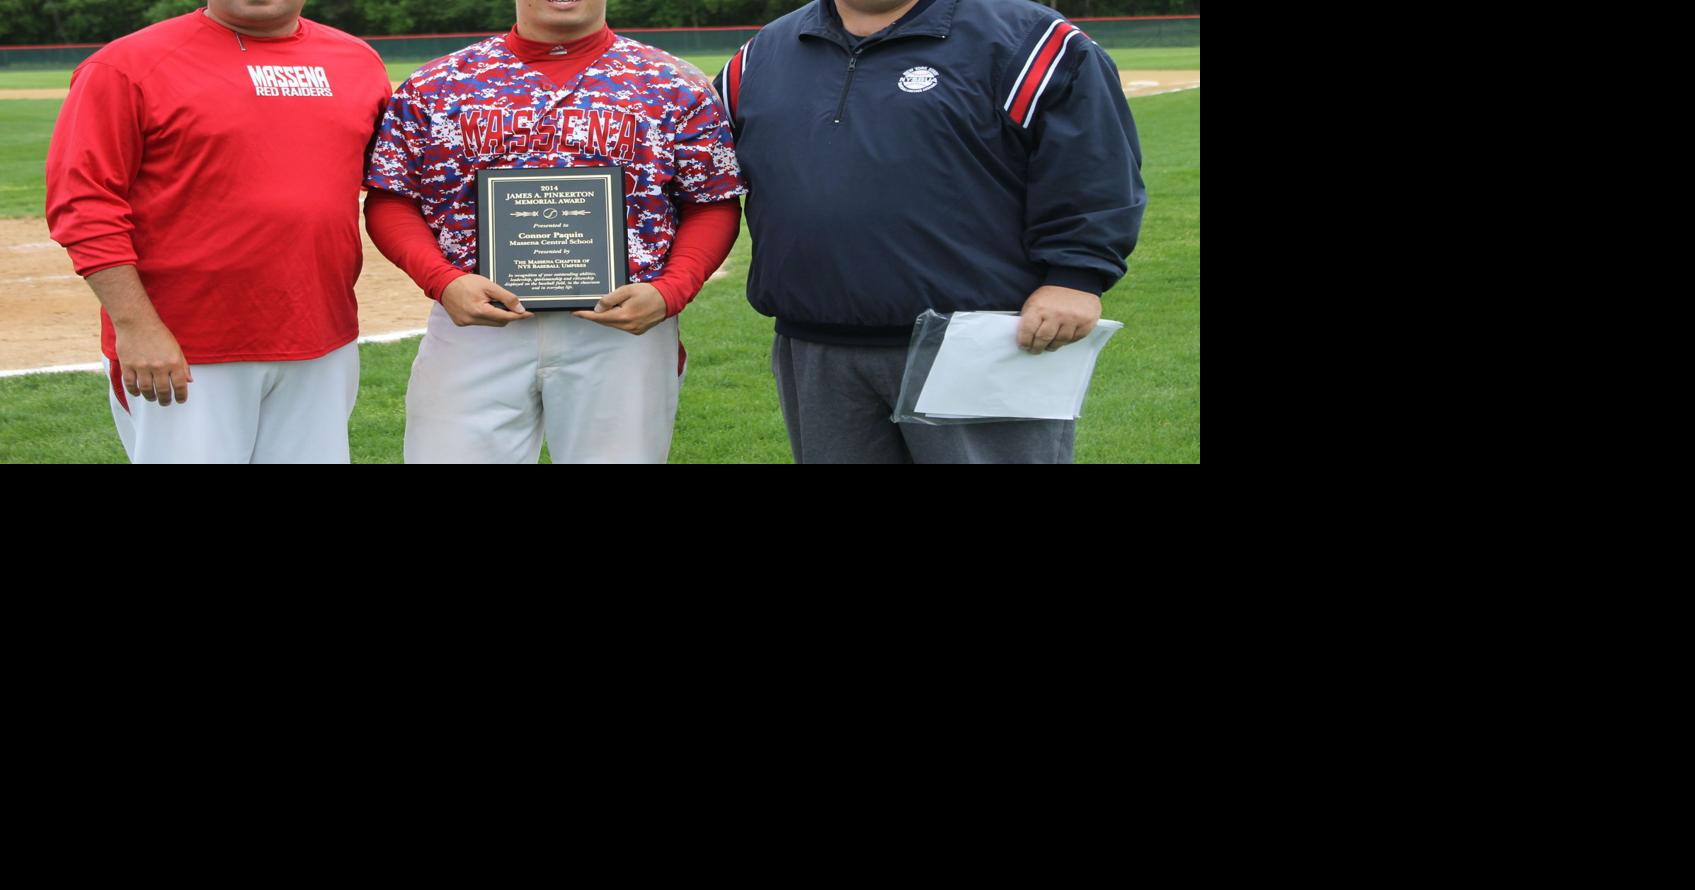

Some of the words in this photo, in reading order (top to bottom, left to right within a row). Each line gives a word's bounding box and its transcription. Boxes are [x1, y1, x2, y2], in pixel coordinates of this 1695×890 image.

[246, 65, 331, 88] MASSENA
[255, 86, 280, 96] RED
[281, 87, 333, 97] RAIDERS
[459, 107, 637, 161] MASSENA
[505, 192, 533, 200] JAMES
[553, 231, 584, 240] Paquin
